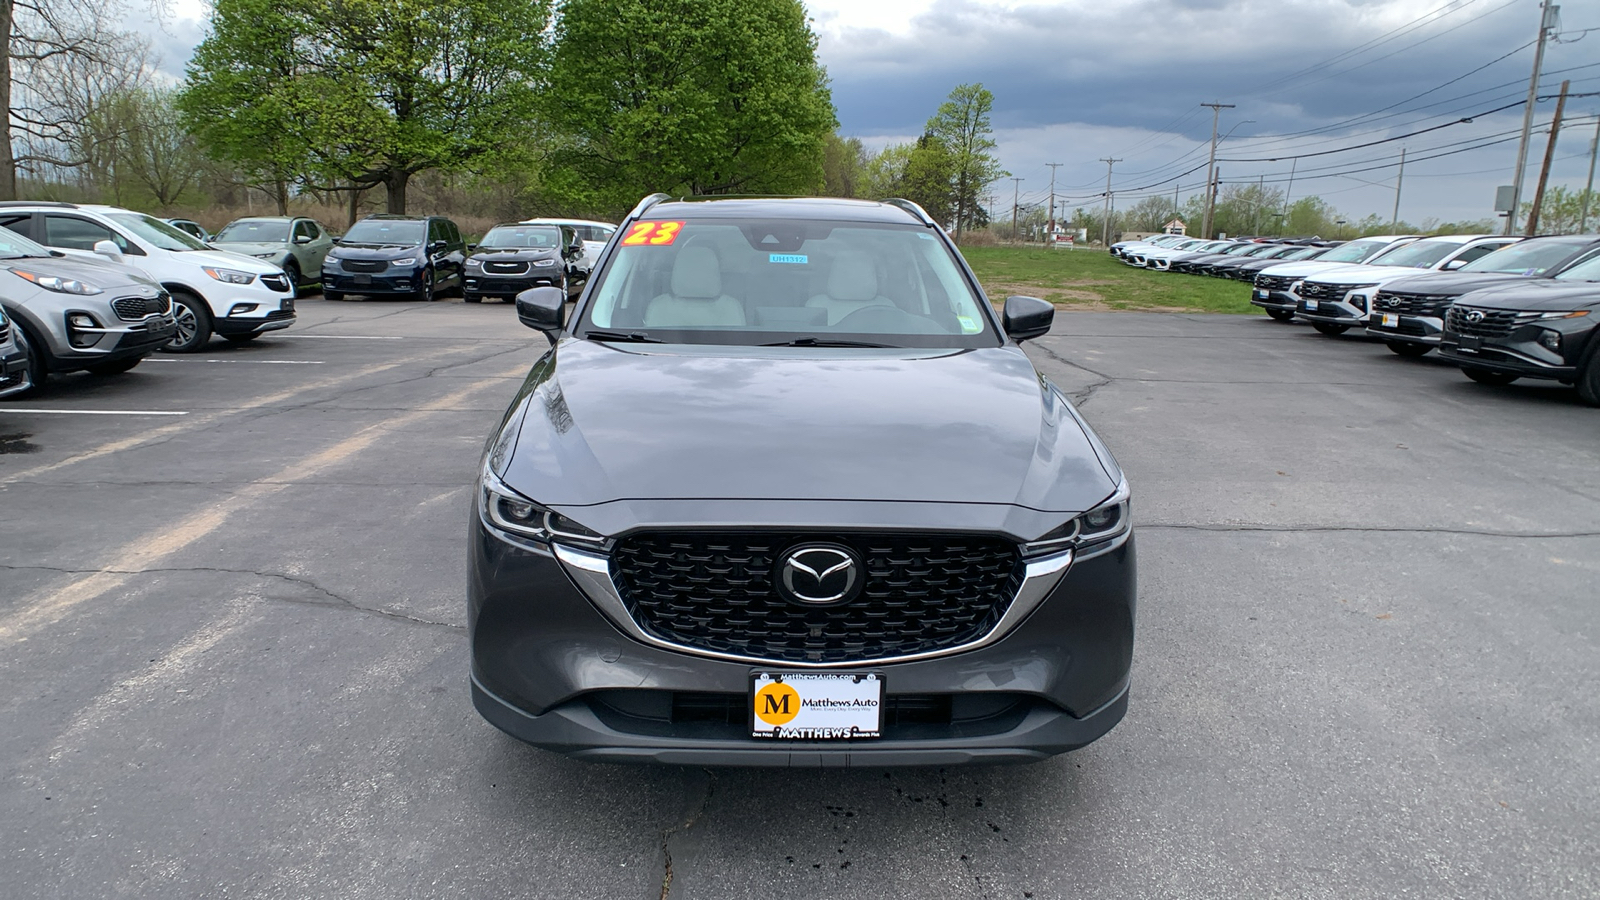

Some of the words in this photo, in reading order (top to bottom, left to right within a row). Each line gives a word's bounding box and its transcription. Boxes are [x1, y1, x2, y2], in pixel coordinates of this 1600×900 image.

[624, 221, 681, 245] 23
[772, 255, 804, 263] UH1312
[780, 673, 856, 681] MatthewsAuto.com
[762, 693, 792, 715] M
[801, 698, 851, 707] Matthews
[852, 698, 878, 707] Auto
[778, 728, 851, 739] MATTHEWS
